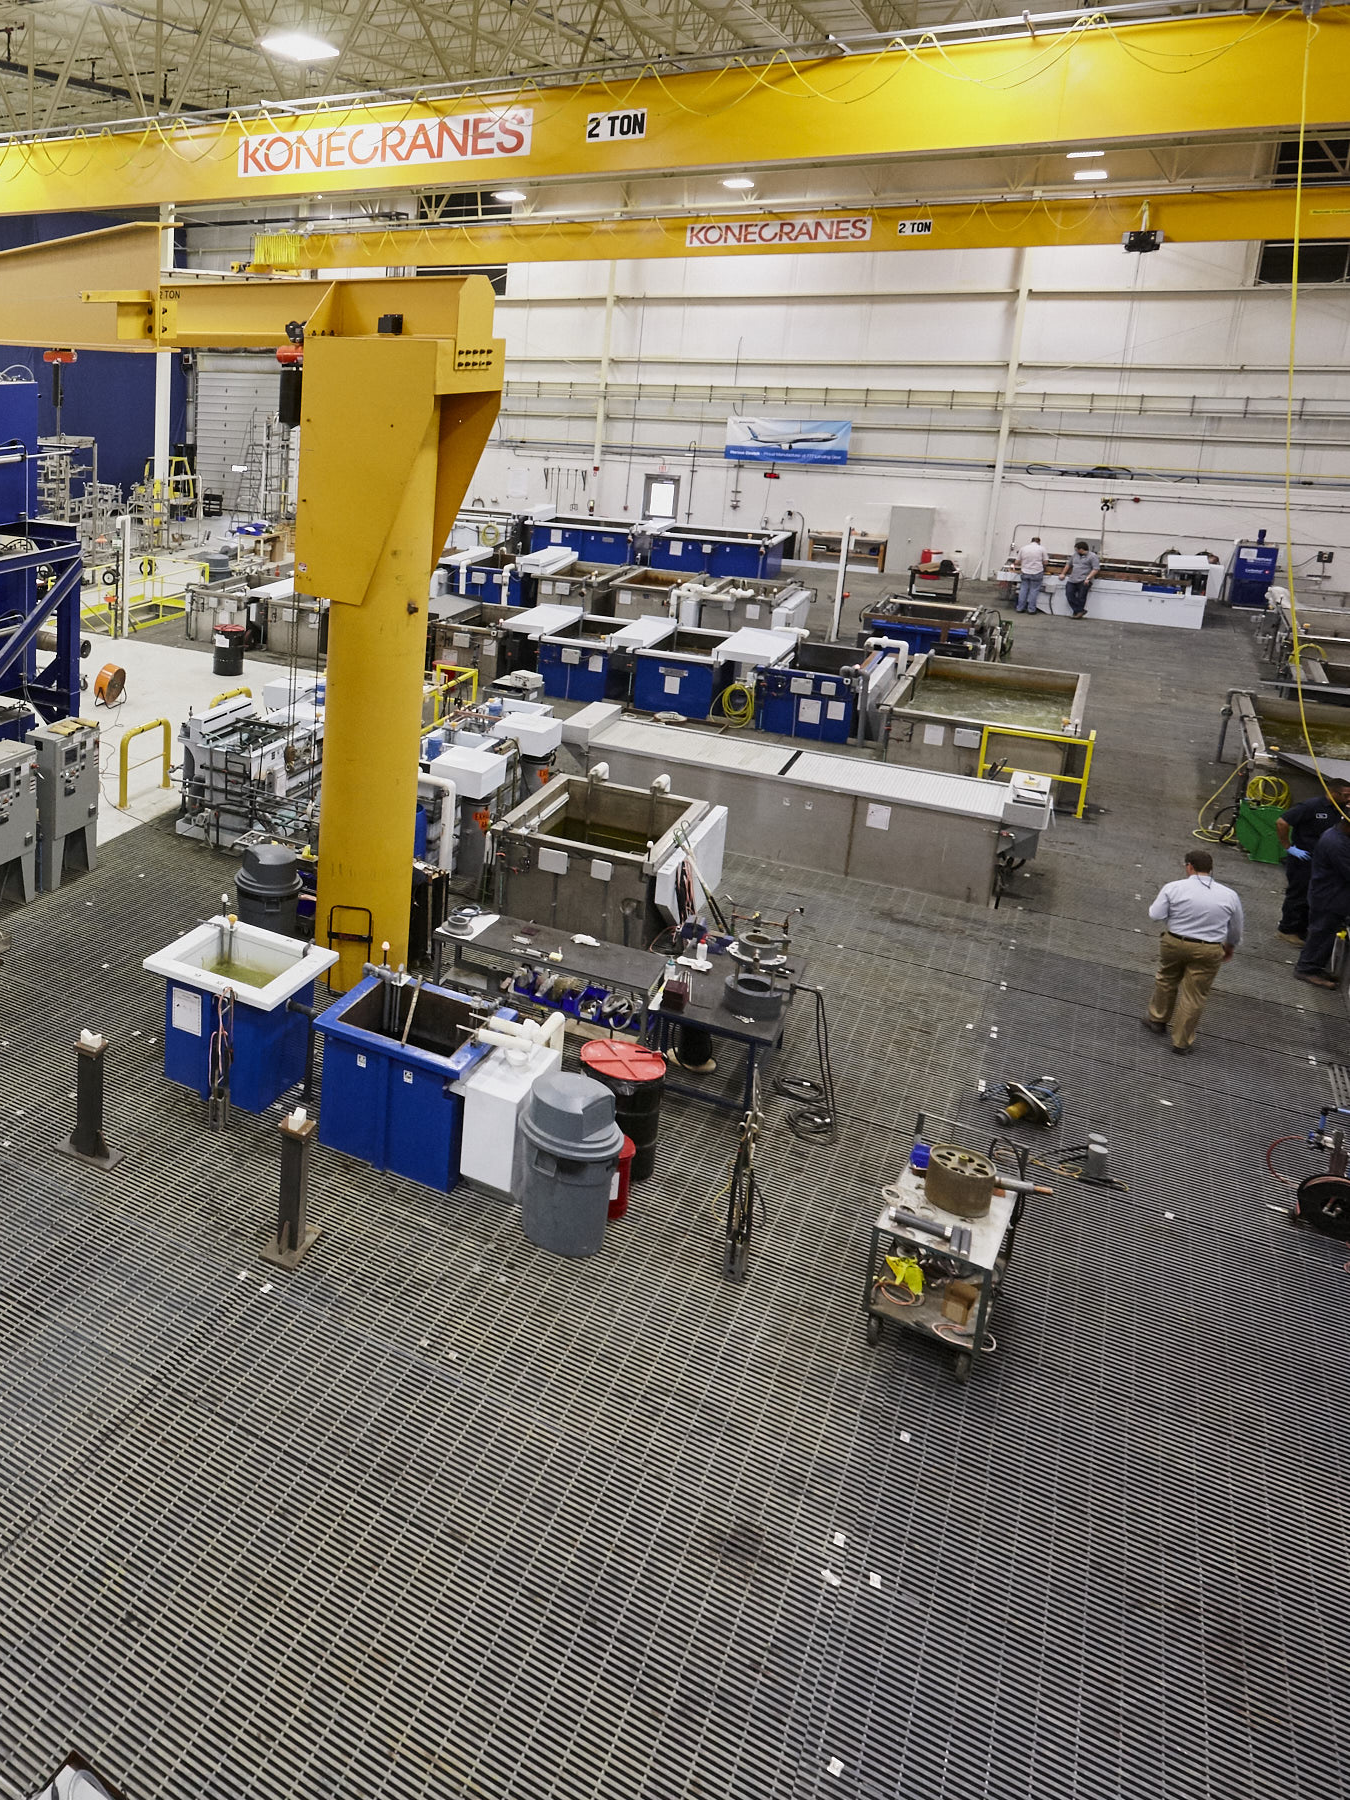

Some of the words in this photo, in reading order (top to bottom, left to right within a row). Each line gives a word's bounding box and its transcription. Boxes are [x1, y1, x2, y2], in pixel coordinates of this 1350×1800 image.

[588, 117, 600, 138] 2
[607, 113, 645, 136] TON
[243, 114, 525, 174] KONECRANES
[689, 218, 867, 245] KONECRANES
[898, 223, 905, 234] 2
[910, 221, 931, 233] TON
[165, 290, 180, 300] TON
